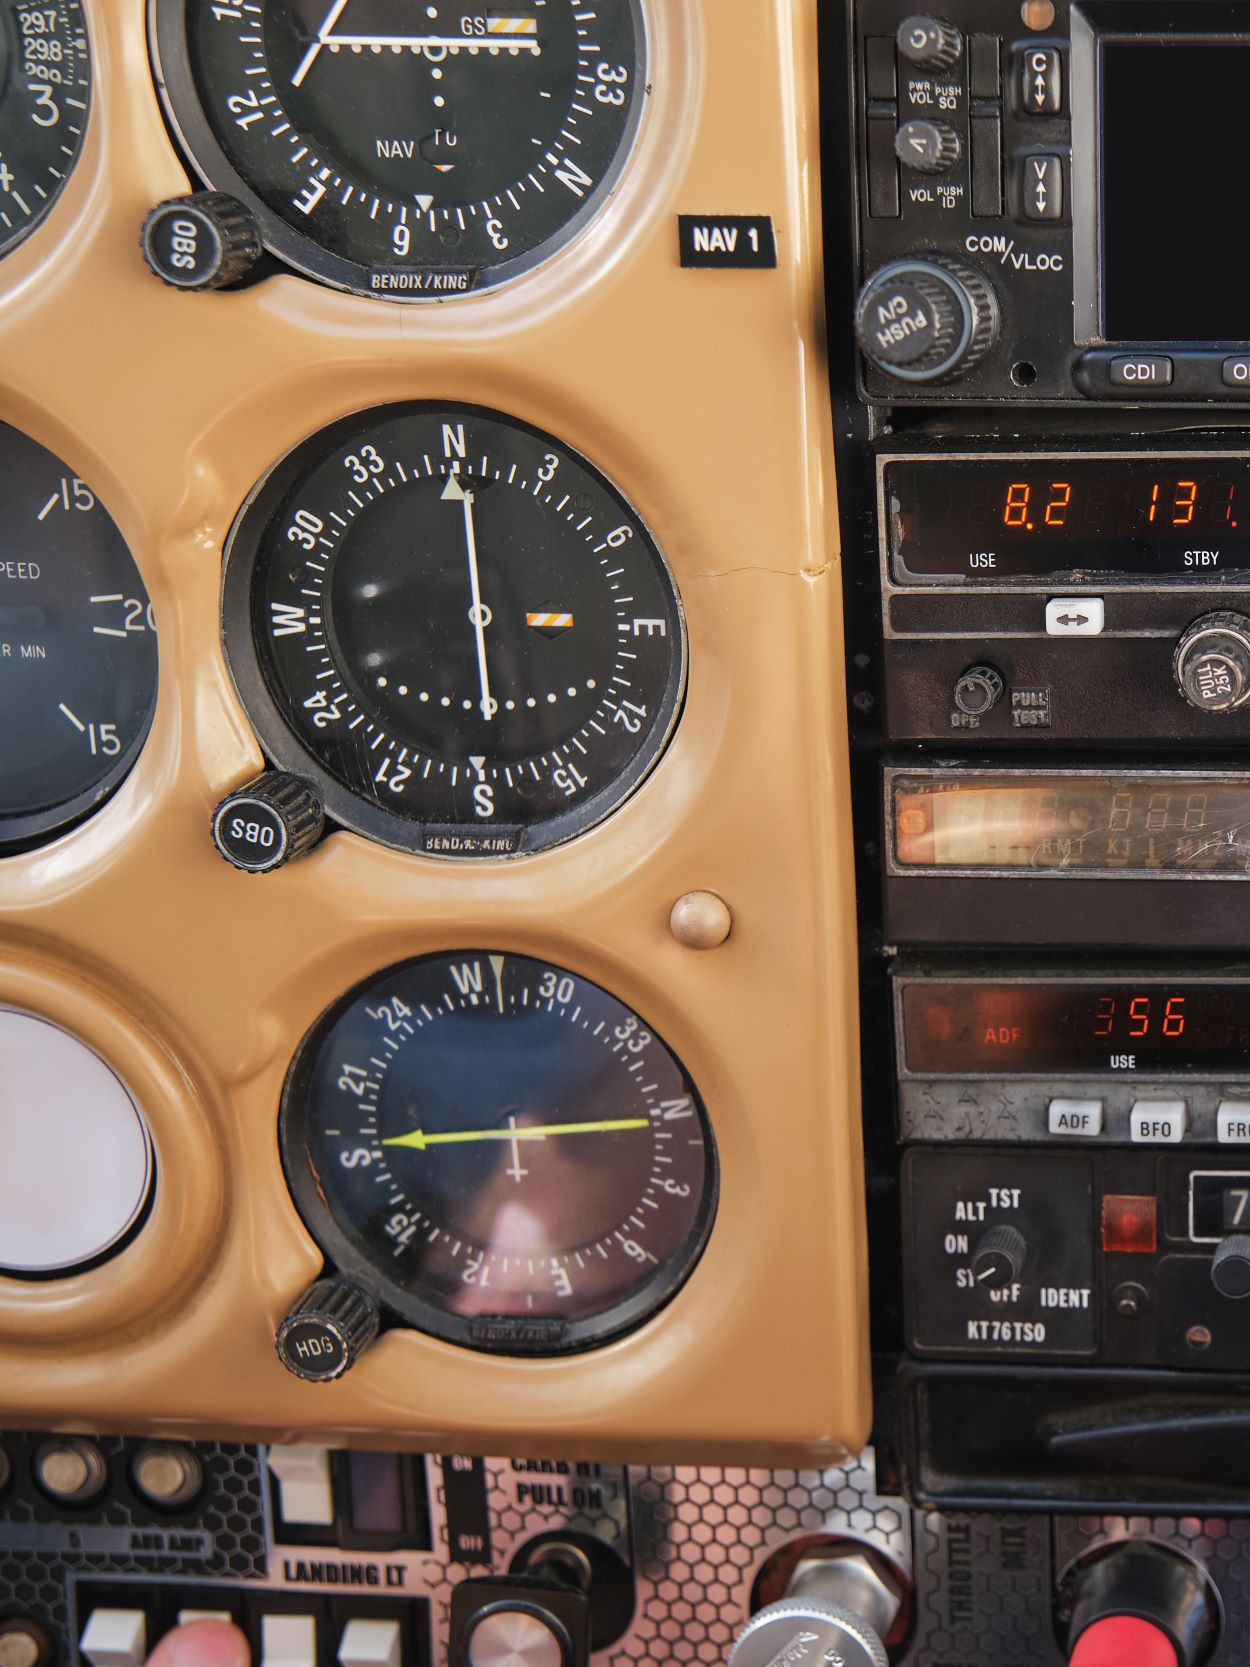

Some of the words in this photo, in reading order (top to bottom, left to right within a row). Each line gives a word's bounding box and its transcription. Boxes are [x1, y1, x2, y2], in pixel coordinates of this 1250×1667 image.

[20, 11, 57, 35] 29.7
[211, 0, 243, 21] 1
[461, 17, 486, 36] GS
[24, 37, 63, 62] 29.8
[1032, 53, 1047, 72] C
[594, 62, 628, 106] 33
[909, 81, 931, 92] PWR
[935, 86, 962, 97] PUSH
[28, 84, 60, 126] 3
[227, 90, 264, 131] 12
[909, 92, 934, 105] VOL
[939, 97, 957, 110] SQ
[376, 140, 414, 158] NAV
[555, 157, 593, 198] N
[1034, 162, 1047, 179] V
[292, 176, 327, 215] E
[910, 190, 934, 202] VOL
[936, 186, 963, 197] PUSH
[943, 196, 955, 209] ID
[171, 220, 197, 270] OBS
[486, 219, 509, 250] 3
[693, 226, 738, 252] NAV
[748, 227, 758, 252] 1
[371, 274, 468, 290] BENDIX/KING
[877, 309, 928, 349] PUSH
[1123, 364, 1155, 380] CDI
[442, 424, 466, 458] N
[344, 445, 384, 483] 33
[538, 453, 560, 482] 3
[61, 478, 95, 511] 15
[1003, 483, 1071, 530] 8.2
[288, 509, 323, 550] 30
[606, 525, 633, 548] 6
[969, 553, 997, 569] USE
[1184, 551, 1219, 567] STBY
[271, 602, 306, 636] W
[633, 618, 666, 636] E
[20, 644, 46, 659] MIN
[1197, 663, 1216, 699] PULL
[1213, 664, 1232, 695] 25K
[303, 690, 341, 728] 24
[1012, 691, 1046, 706] PULL
[613, 699, 647, 734] 12
[89, 722, 121, 755] 15
[374, 757, 412, 792] 21
[553, 763, 588, 796] 15
[473, 785, 494, 816] S
[231, 817, 273, 847] OBS
[450, 961, 483, 995] W
[539, 972, 574, 1003] 30
[377, 997, 412, 1030] 24
[614, 1015, 651, 1053] 33
[984, 1027, 1022, 1045] ADF
[1110, 1055, 1136, 1070] USE
[338, 1063, 368, 1095] 21
[660, 1098, 693, 1122] N
[1058, 1115, 1090, 1130] ADF
[1140, 1122, 1172, 1138] BFO
[340, 1148, 373, 1168] S
[664, 1178, 690, 1197] 3
[988, 1188, 1021, 1208] TST
[955, 1201, 986, 1221] ALT
[1229, 1190, 1249, 1225] 7
[944, 1234, 968, 1254] ON
[462, 1258, 490, 1288] 12
[551, 1267, 572, 1297] E
[1040, 1287, 1091, 1308] IDENT
[296, 1337, 334, 1359] HDG
[516, 1482, 569, 1506] PULL
[573, 1488, 603, 1509] ON
[284, 1561, 380, 1585] LANDING
[386, 1565, 406, 1586] LT
[948, 1523, 974, 1625] THROTTLE
